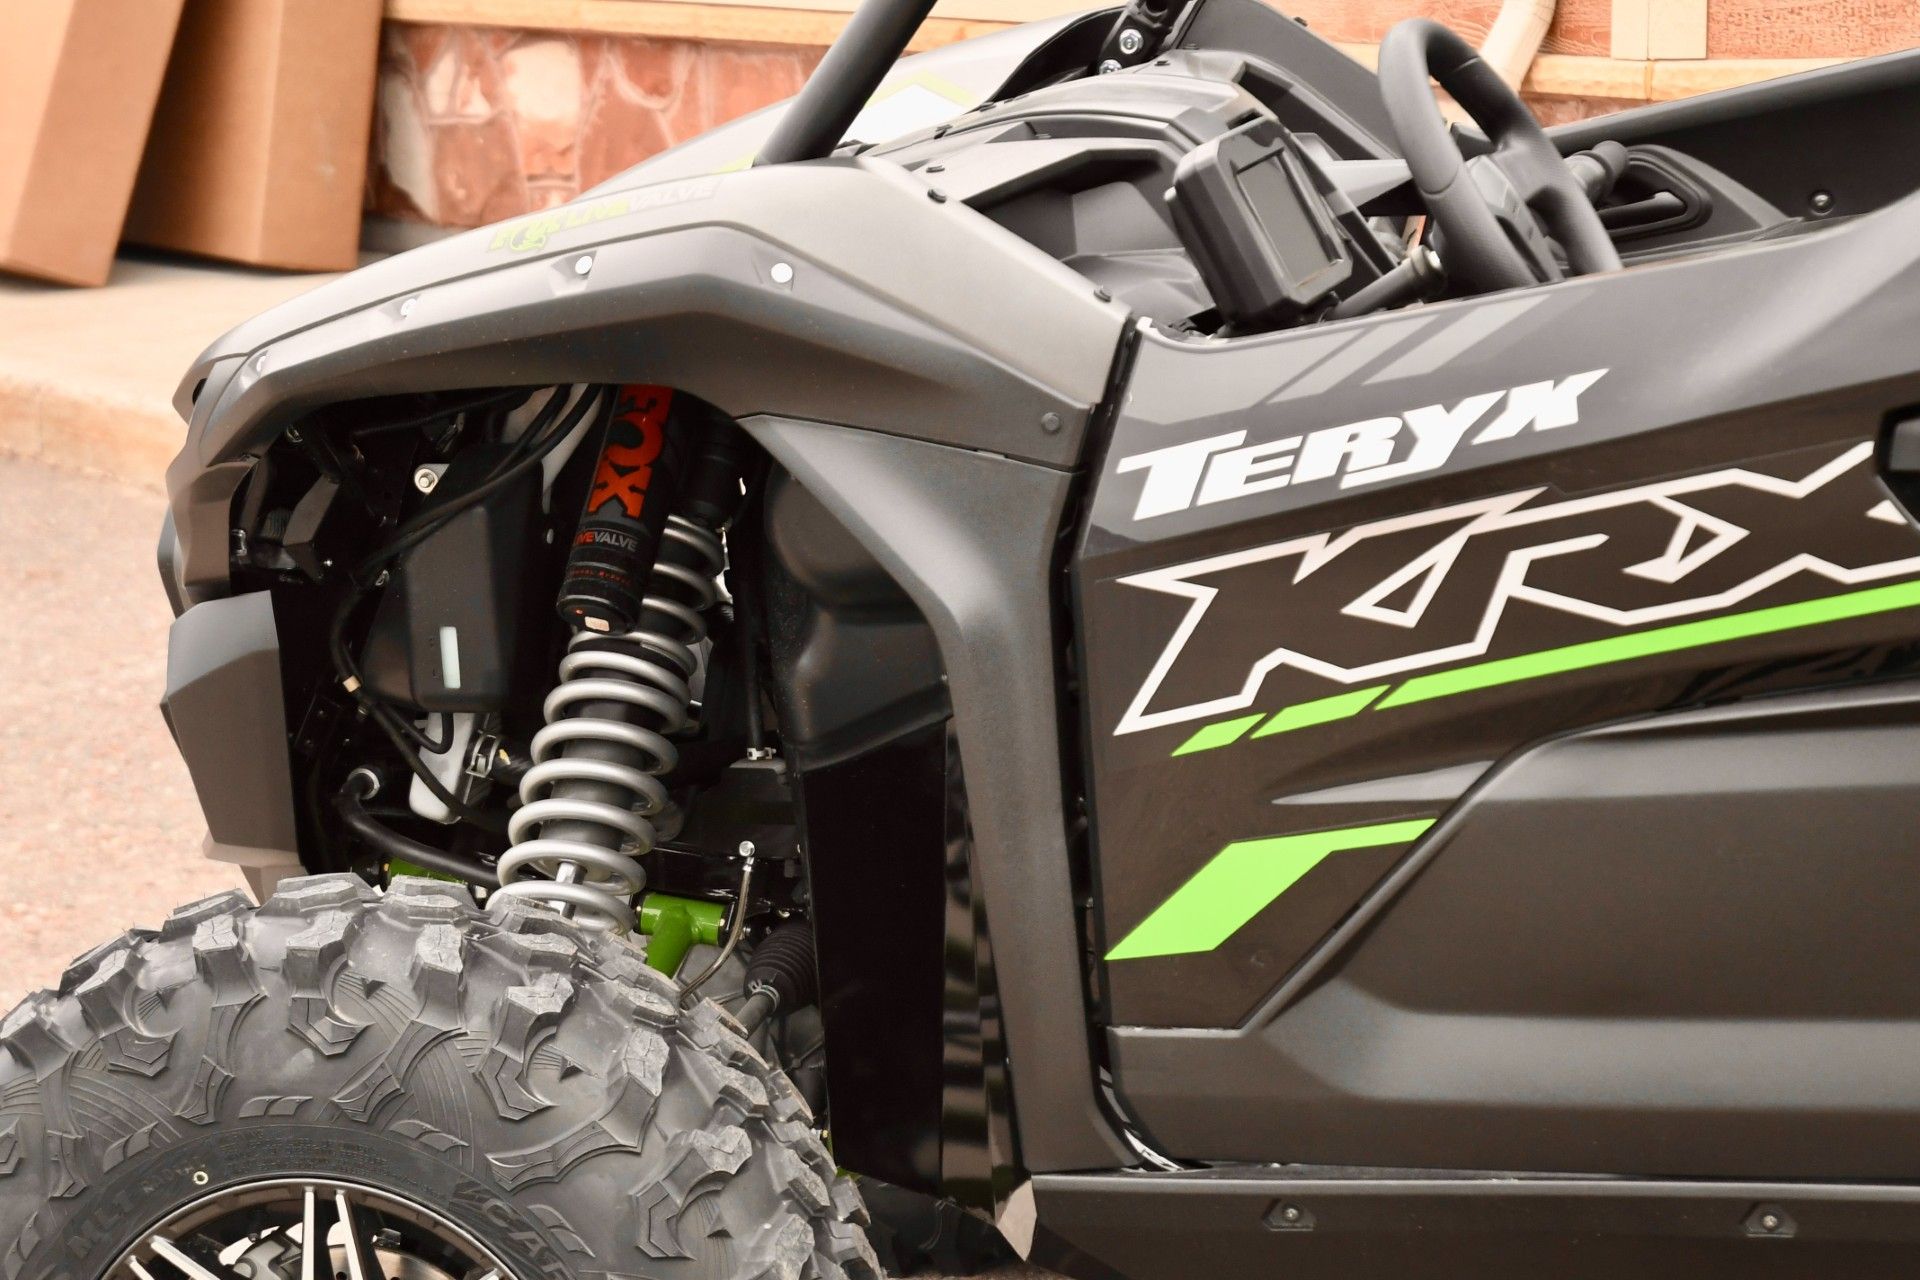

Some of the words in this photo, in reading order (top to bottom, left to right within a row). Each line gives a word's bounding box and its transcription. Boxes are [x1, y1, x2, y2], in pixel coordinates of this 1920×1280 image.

[587, 384, 673, 518] FOX
[1116, 369, 1609, 521] TERYX
[1113, 441, 1920, 736] KRX
